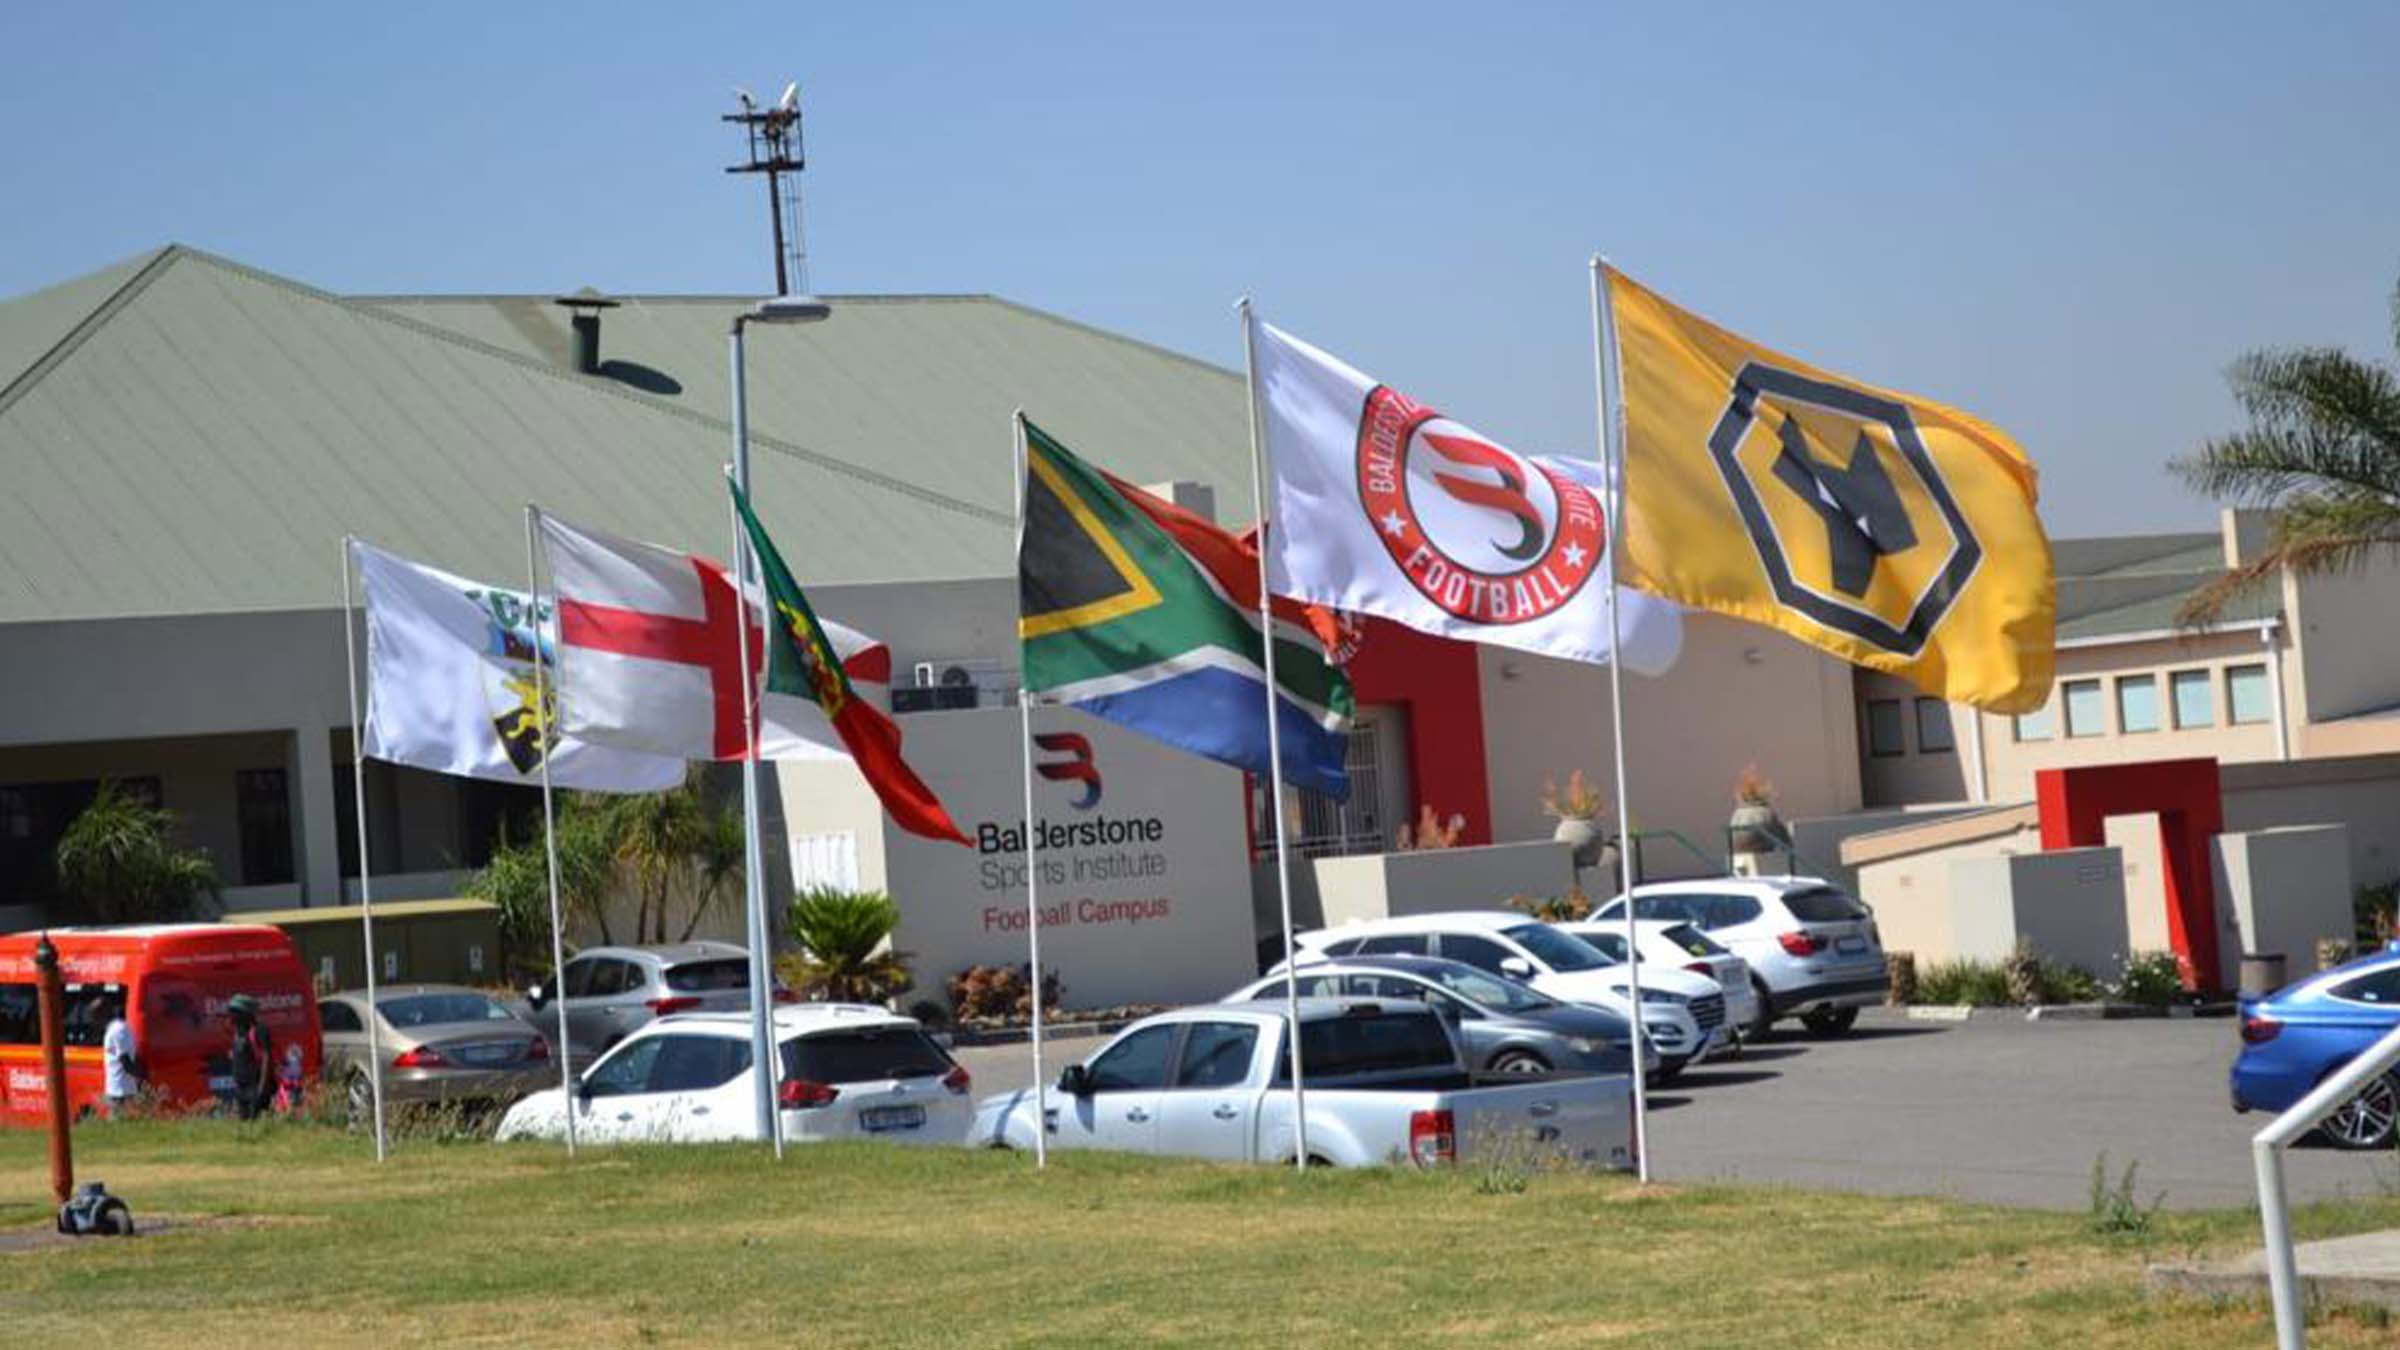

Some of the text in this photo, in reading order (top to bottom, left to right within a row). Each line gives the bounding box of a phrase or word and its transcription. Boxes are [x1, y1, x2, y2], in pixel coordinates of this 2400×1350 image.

[1406, 545, 1570, 617] FOOTBALL
[978, 816, 1163, 853] Balderstone
[1074, 850, 1167, 881] Institute
[1078, 898, 1170, 924] Campus
